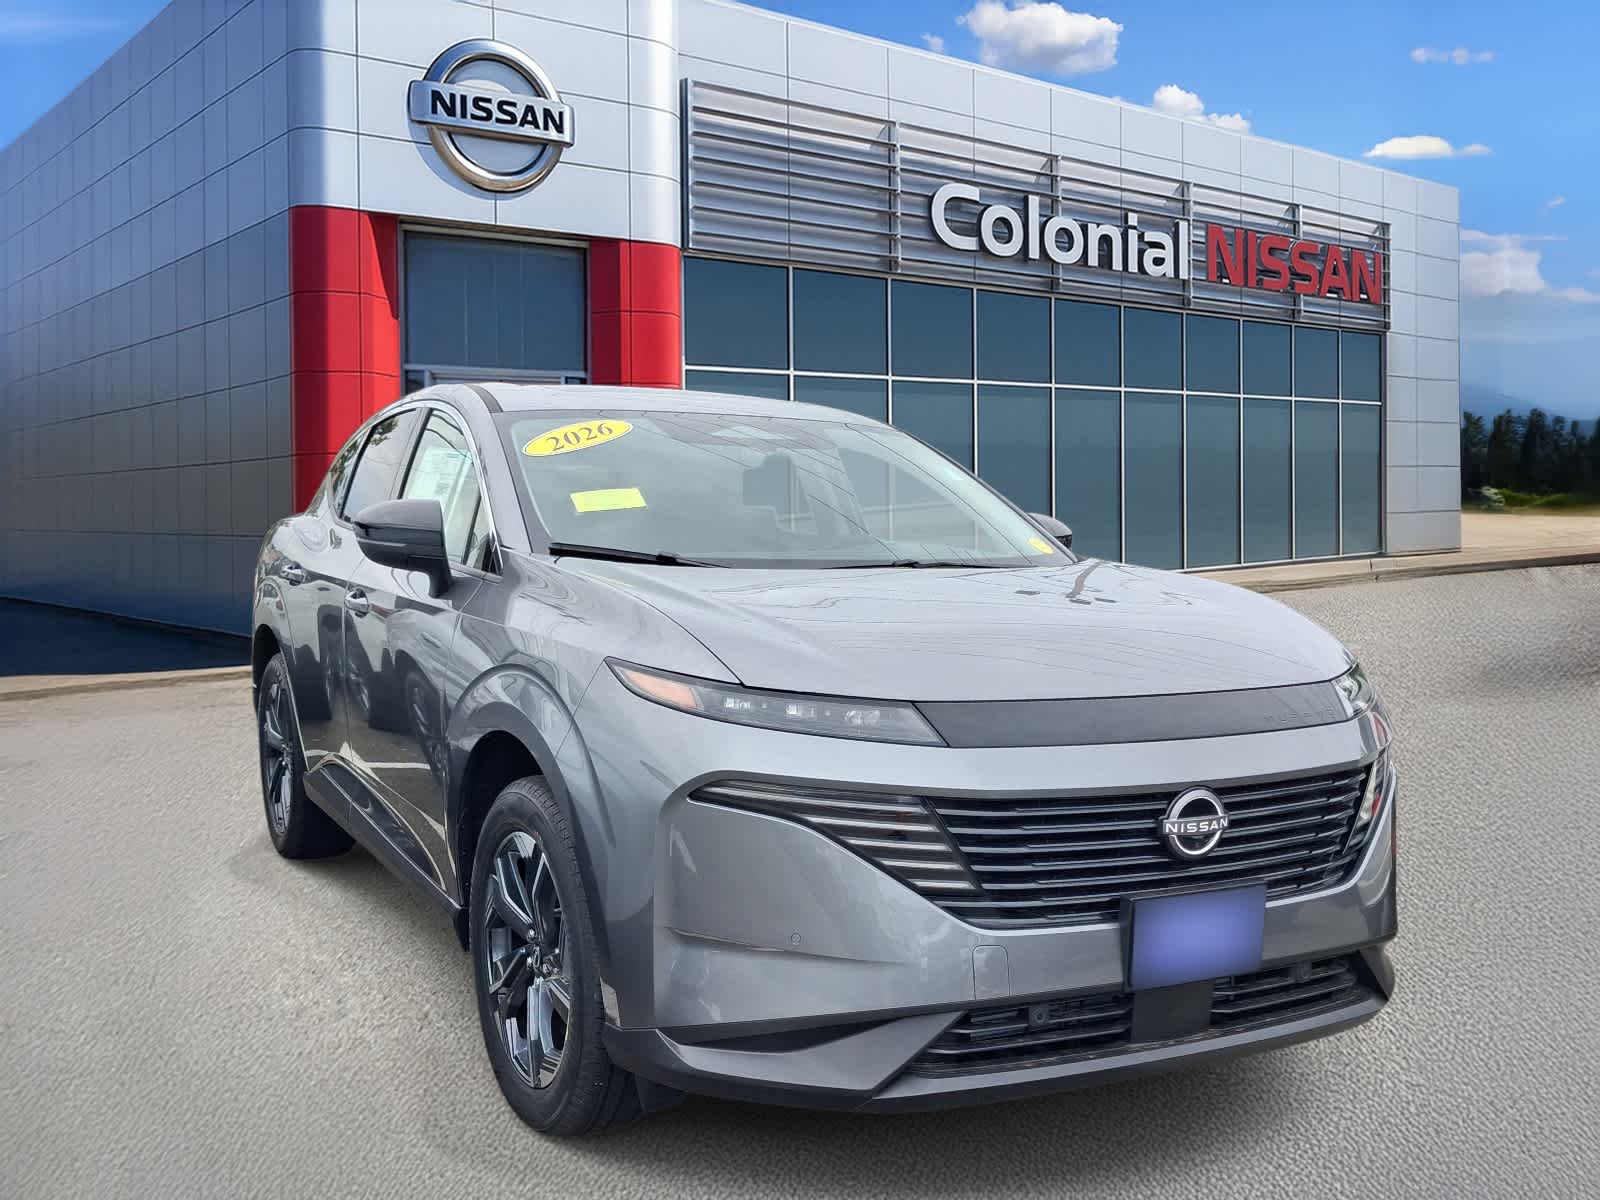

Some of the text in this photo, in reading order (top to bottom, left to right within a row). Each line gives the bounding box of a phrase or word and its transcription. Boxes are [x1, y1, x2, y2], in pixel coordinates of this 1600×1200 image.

[431, 89, 565, 134] NISSAN
[931, 182, 1383, 304] Colonial NISSAN
[545, 421, 615, 452] 2026
[1165, 817, 1229, 834] NISSAN
